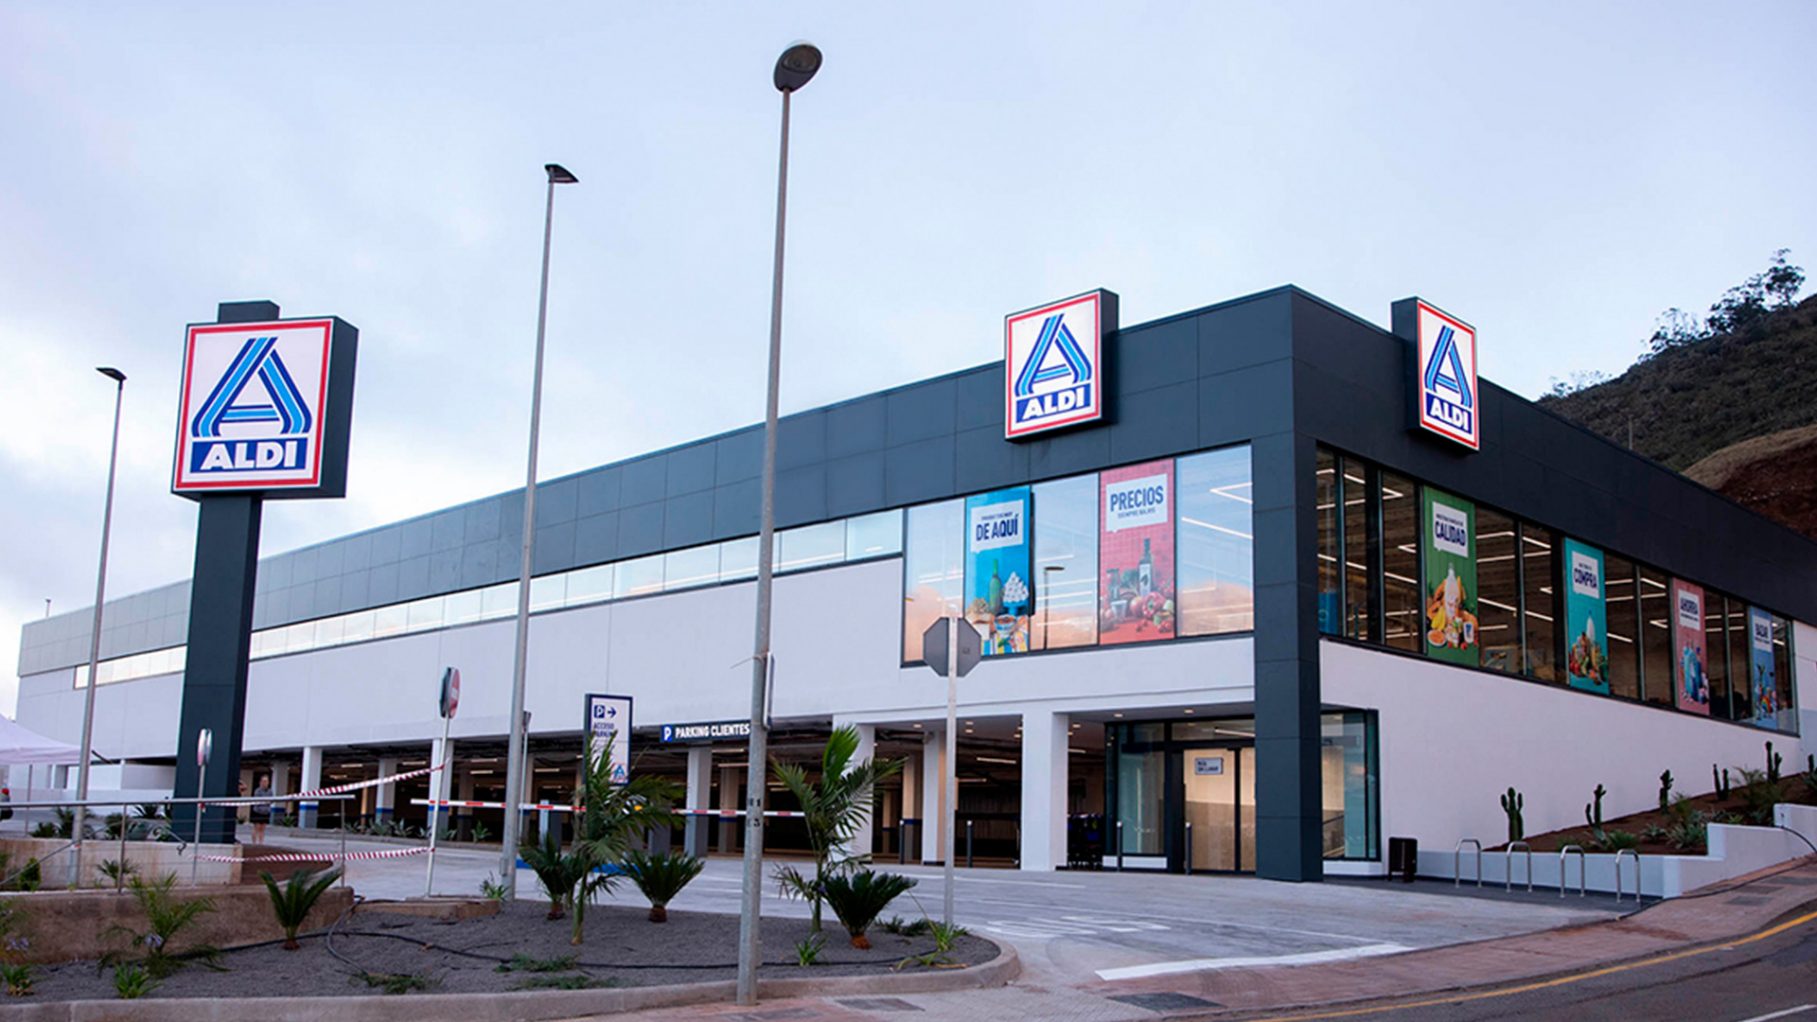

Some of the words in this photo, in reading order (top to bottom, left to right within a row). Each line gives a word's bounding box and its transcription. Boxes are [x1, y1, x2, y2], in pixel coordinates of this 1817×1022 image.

[1021, 386, 1086, 421] ALDI
[1429, 397, 1470, 432] ALDI
[199, 440, 299, 471] ALDI
[1110, 485, 1164, 512] PRECIOS
[976, 522, 990, 541] DE
[991, 513, 1019, 539] AQUÍ
[1435, 520, 1466, 547] CALIDAD
[675, 725, 709, 739] PARKING
[710, 723, 751, 737] CLIENTES
